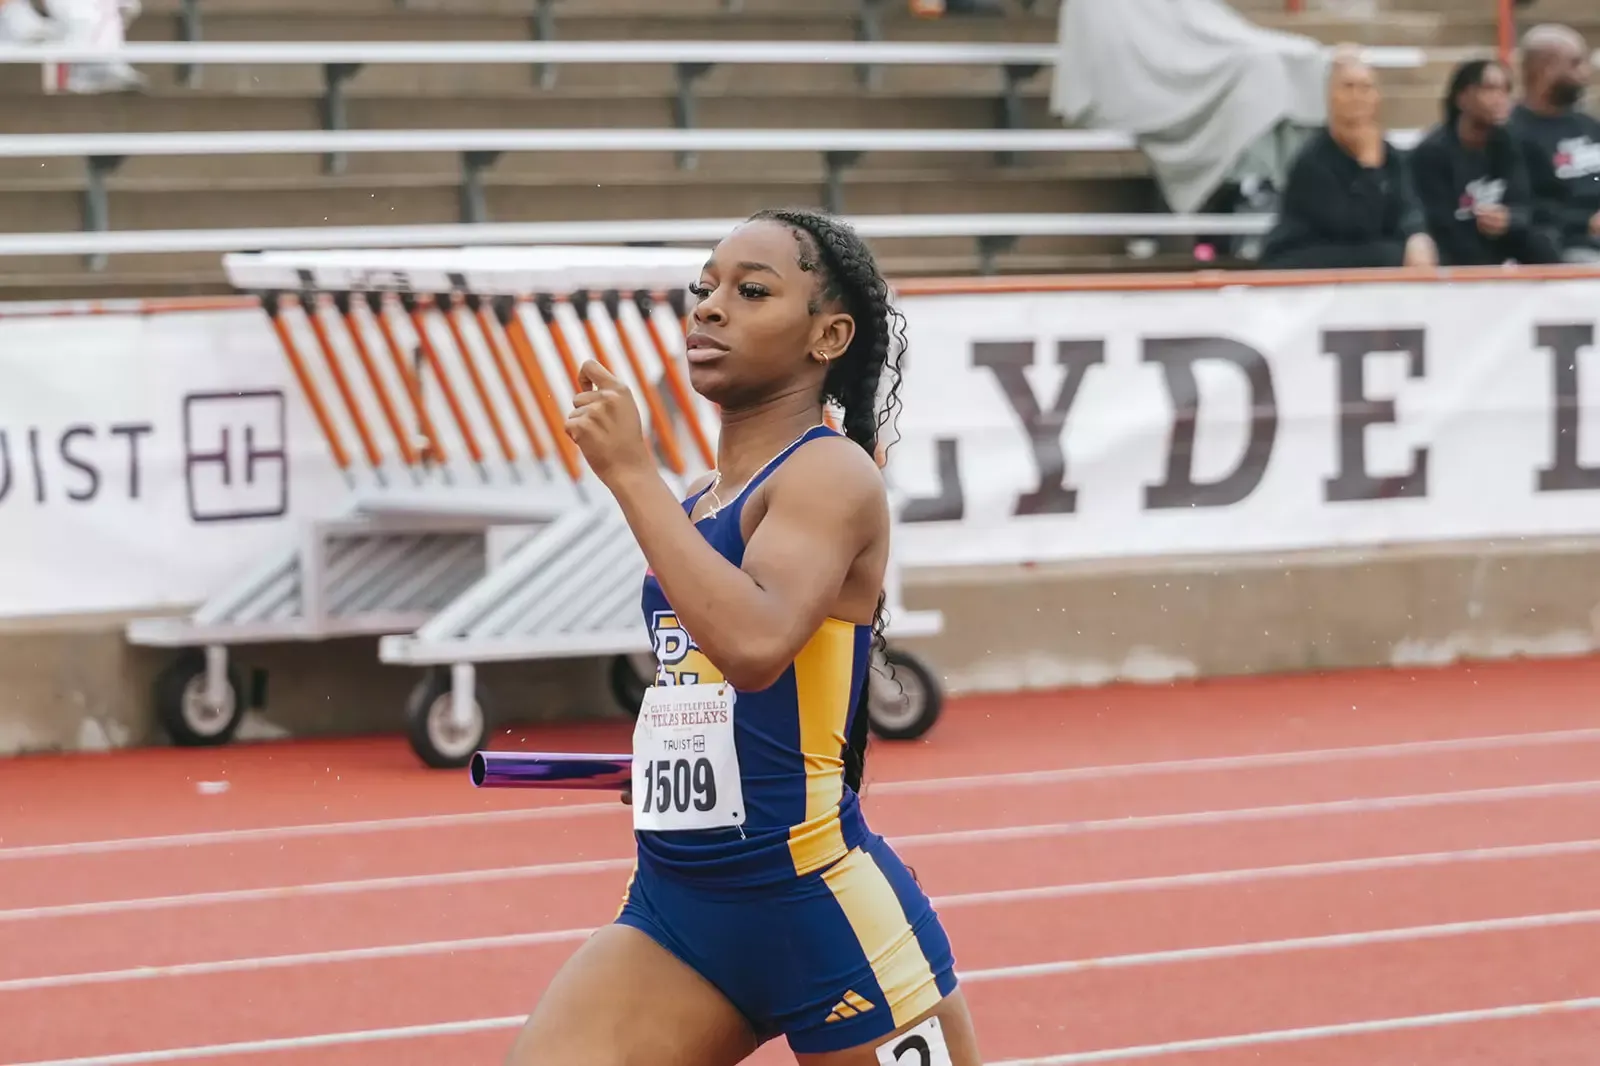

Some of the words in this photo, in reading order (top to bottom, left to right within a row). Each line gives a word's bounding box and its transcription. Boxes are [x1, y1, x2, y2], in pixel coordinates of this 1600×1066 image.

[651, 713, 679, 727] TEXAS
[681, 710, 728, 726] RELAYS
[663, 738, 692, 750] TRUIST
[642, 757, 717, 813] 1509
